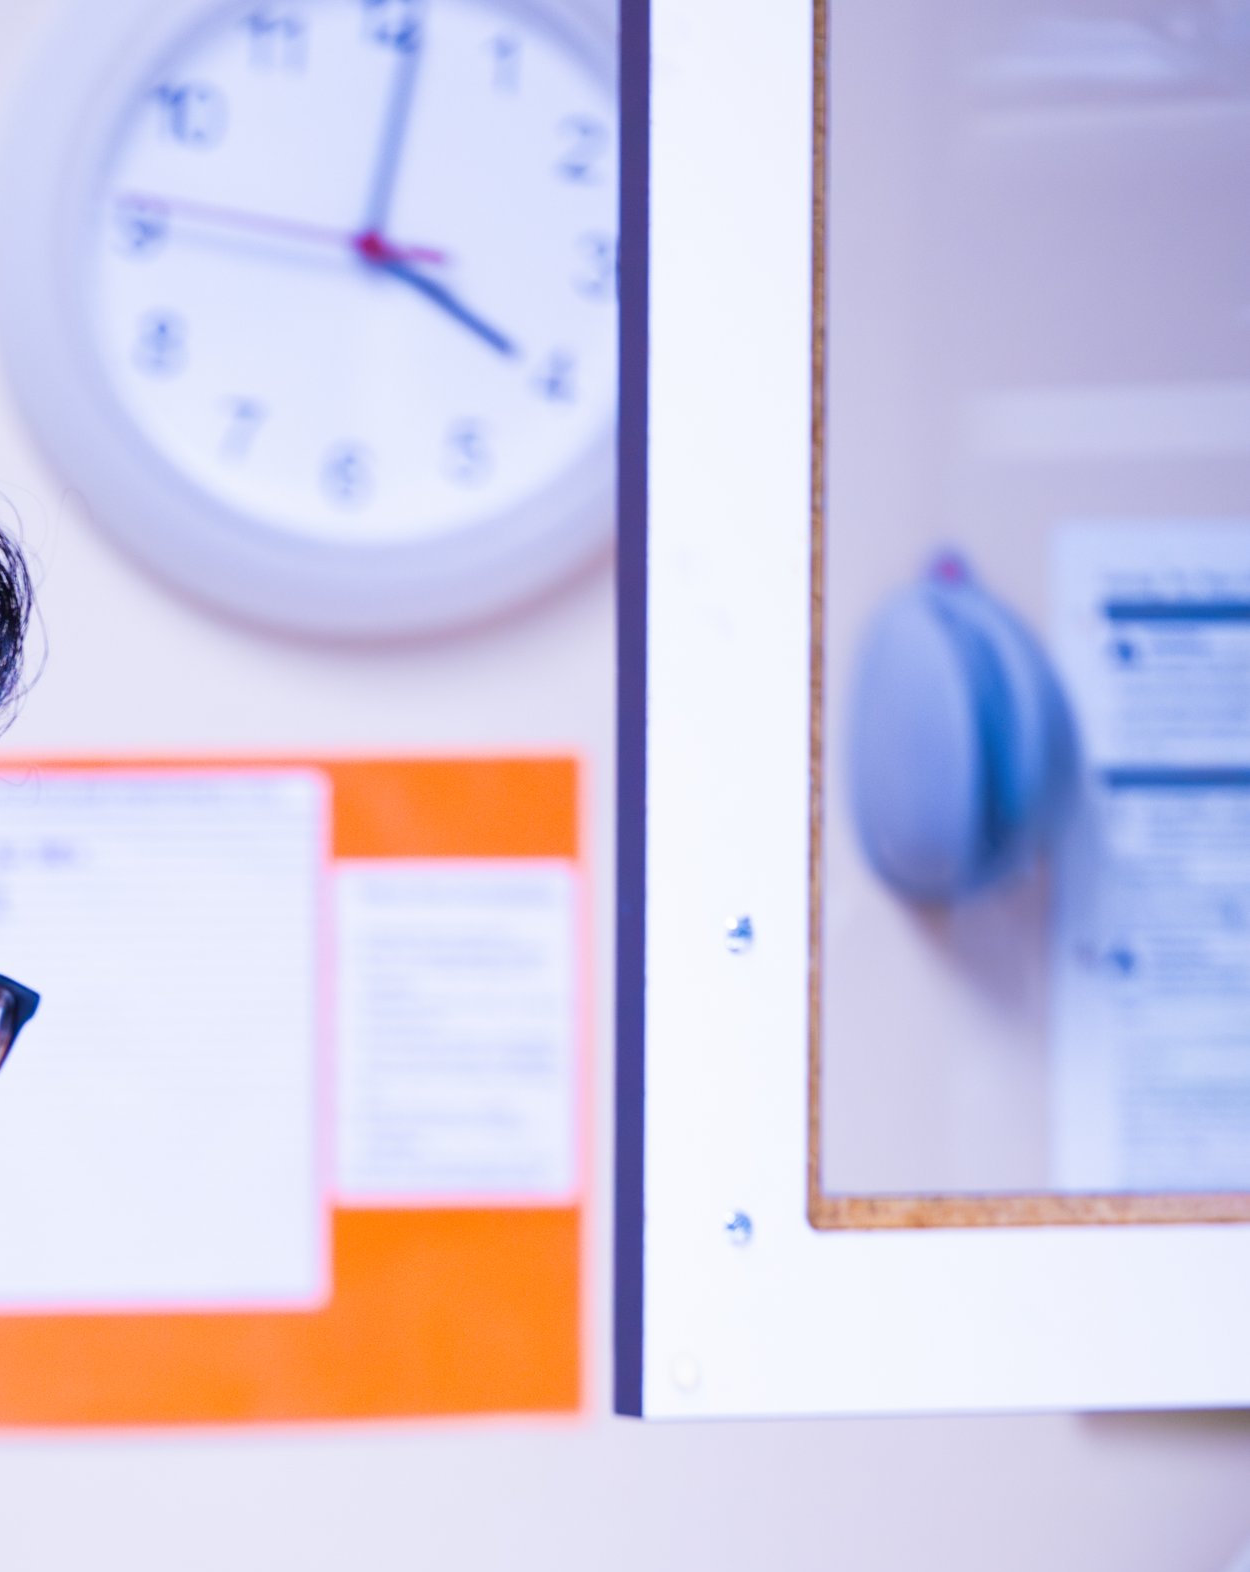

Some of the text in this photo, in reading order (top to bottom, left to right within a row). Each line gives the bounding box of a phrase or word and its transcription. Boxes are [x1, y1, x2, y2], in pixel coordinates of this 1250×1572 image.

[152, 80, 227, 150] 10
[557, 115, 607, 184] 2
[571, 229, 618, 303] 3
[135, 310, 187, 380] 8
[530, 346, 578, 404] 4
[219, 396, 265, 463] 7
[444, 419, 494, 486] 5
[321, 443, 373, 510] 6
